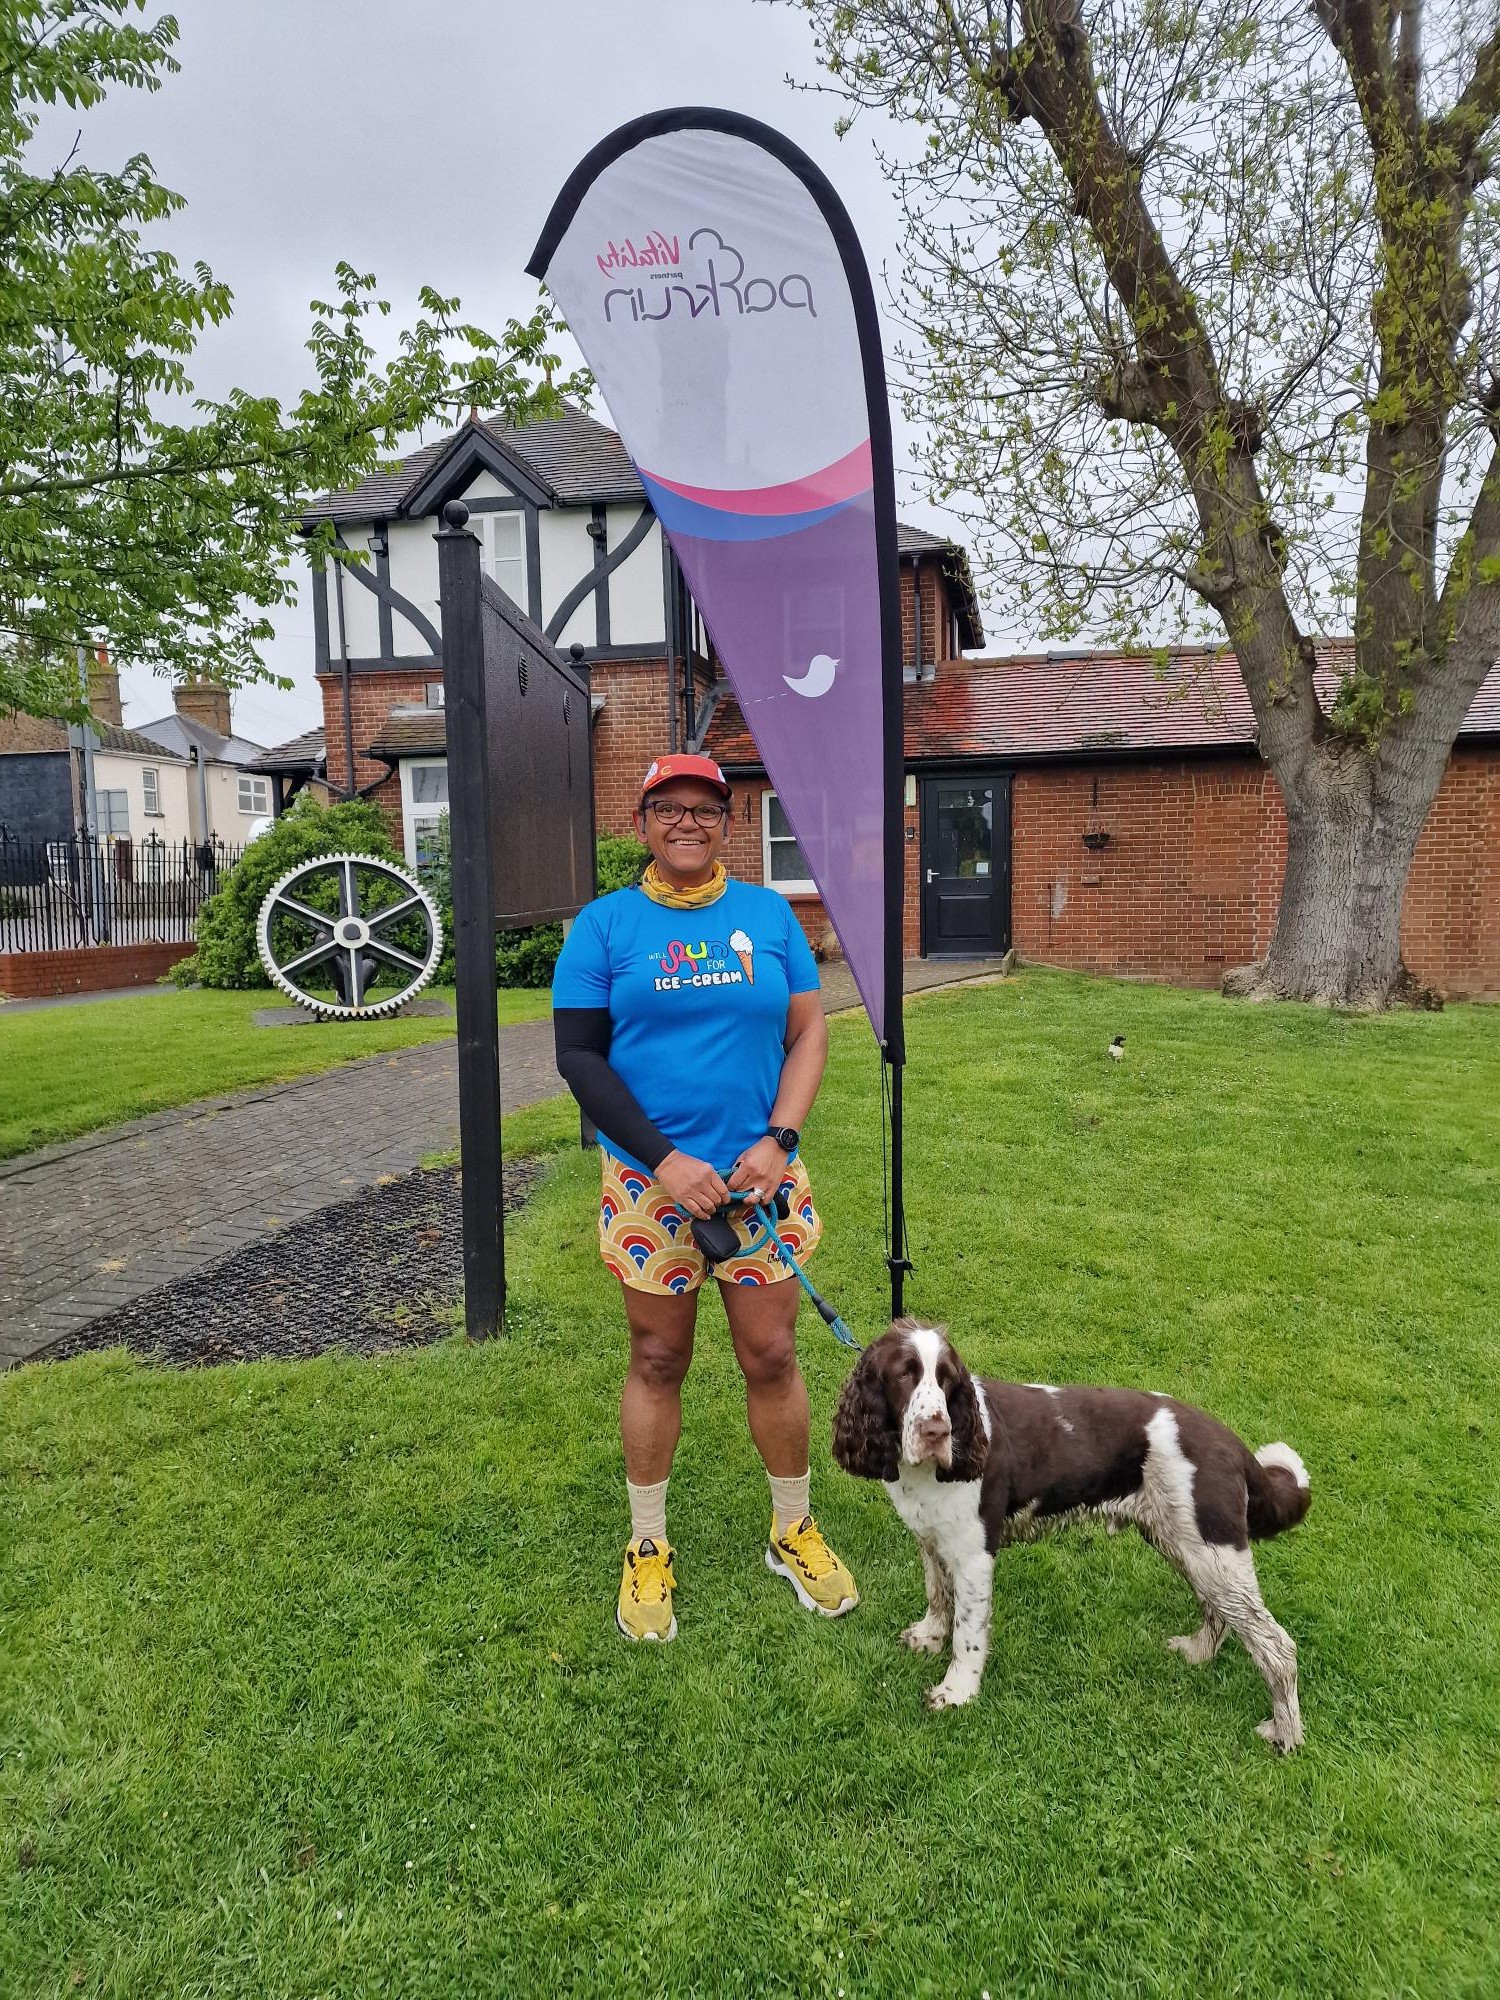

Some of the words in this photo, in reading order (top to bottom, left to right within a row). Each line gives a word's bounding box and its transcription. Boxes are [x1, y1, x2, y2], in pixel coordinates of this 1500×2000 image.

[648, 953, 667, 961] WILL
[706, 960, 726, 970] FOR
[654, 971, 743, 991] ICE-CREAM
